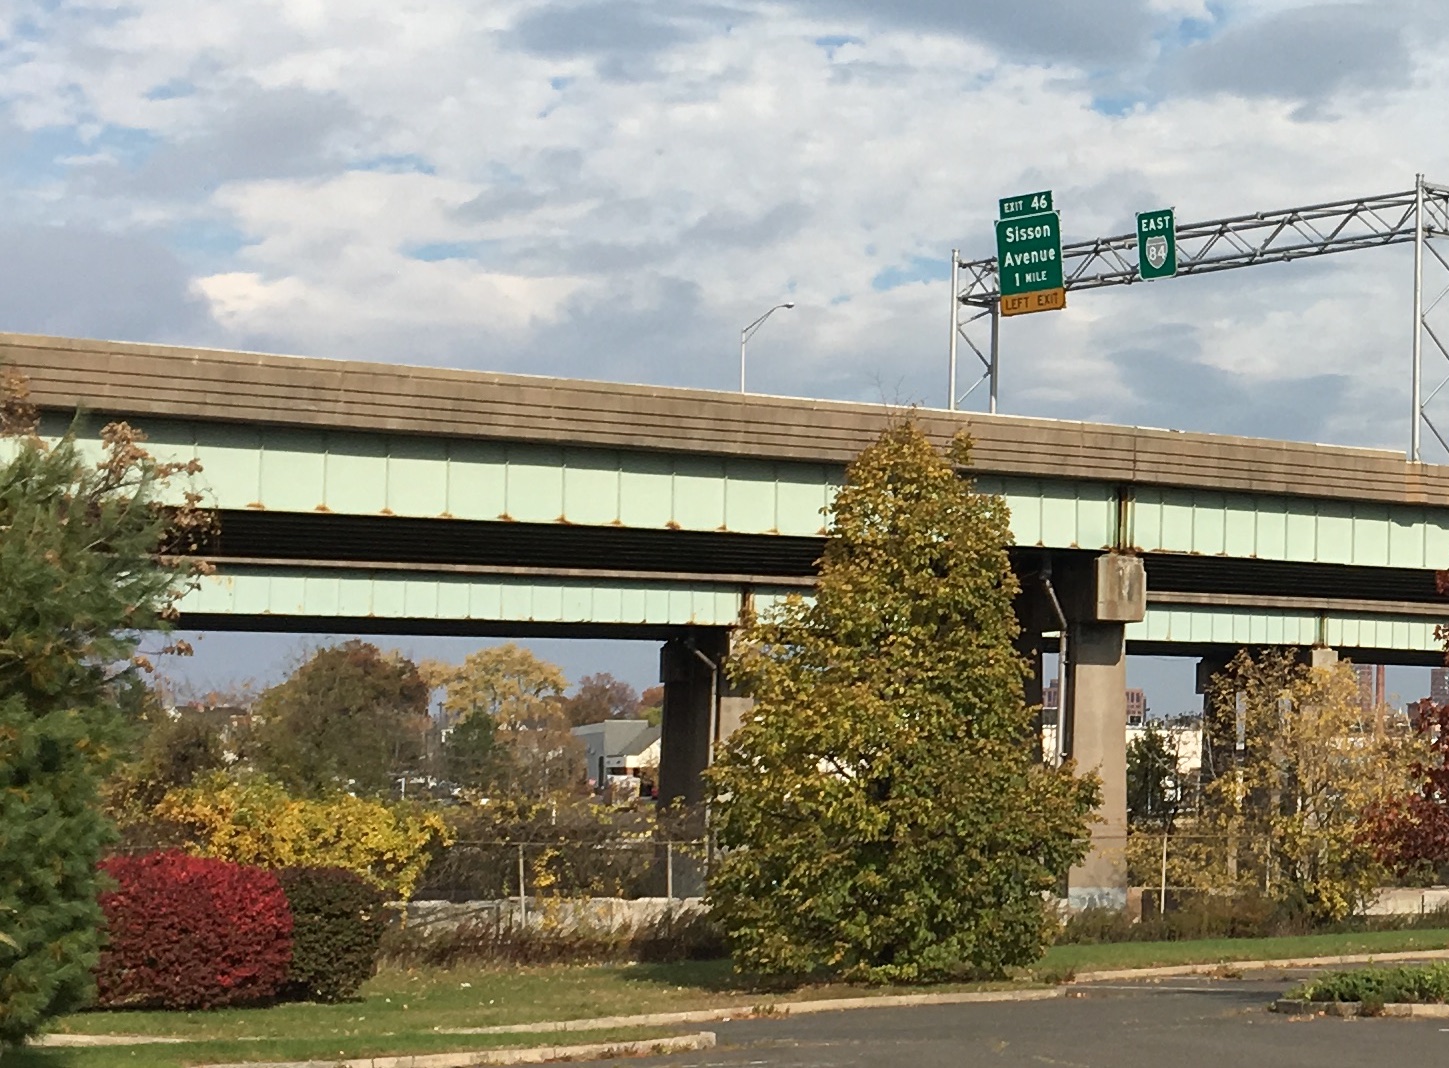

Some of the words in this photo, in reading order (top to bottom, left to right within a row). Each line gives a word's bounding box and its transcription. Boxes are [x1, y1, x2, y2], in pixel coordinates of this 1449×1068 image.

[1004, 201, 1023, 213] EXIT
[1031, 195, 1048, 210] 46
[1142, 216, 1171, 231] EAST
[1006, 225, 1051, 242] Sisson
[1004, 248, 1056, 267] Avenue
[1149, 245, 1166, 260] 84
[1015, 273, 1020, 286] 1
[1025, 271, 1047, 283] MILE
[1005, 297, 1029, 311] LEFT
[1037, 293, 1058, 306] EXIT
